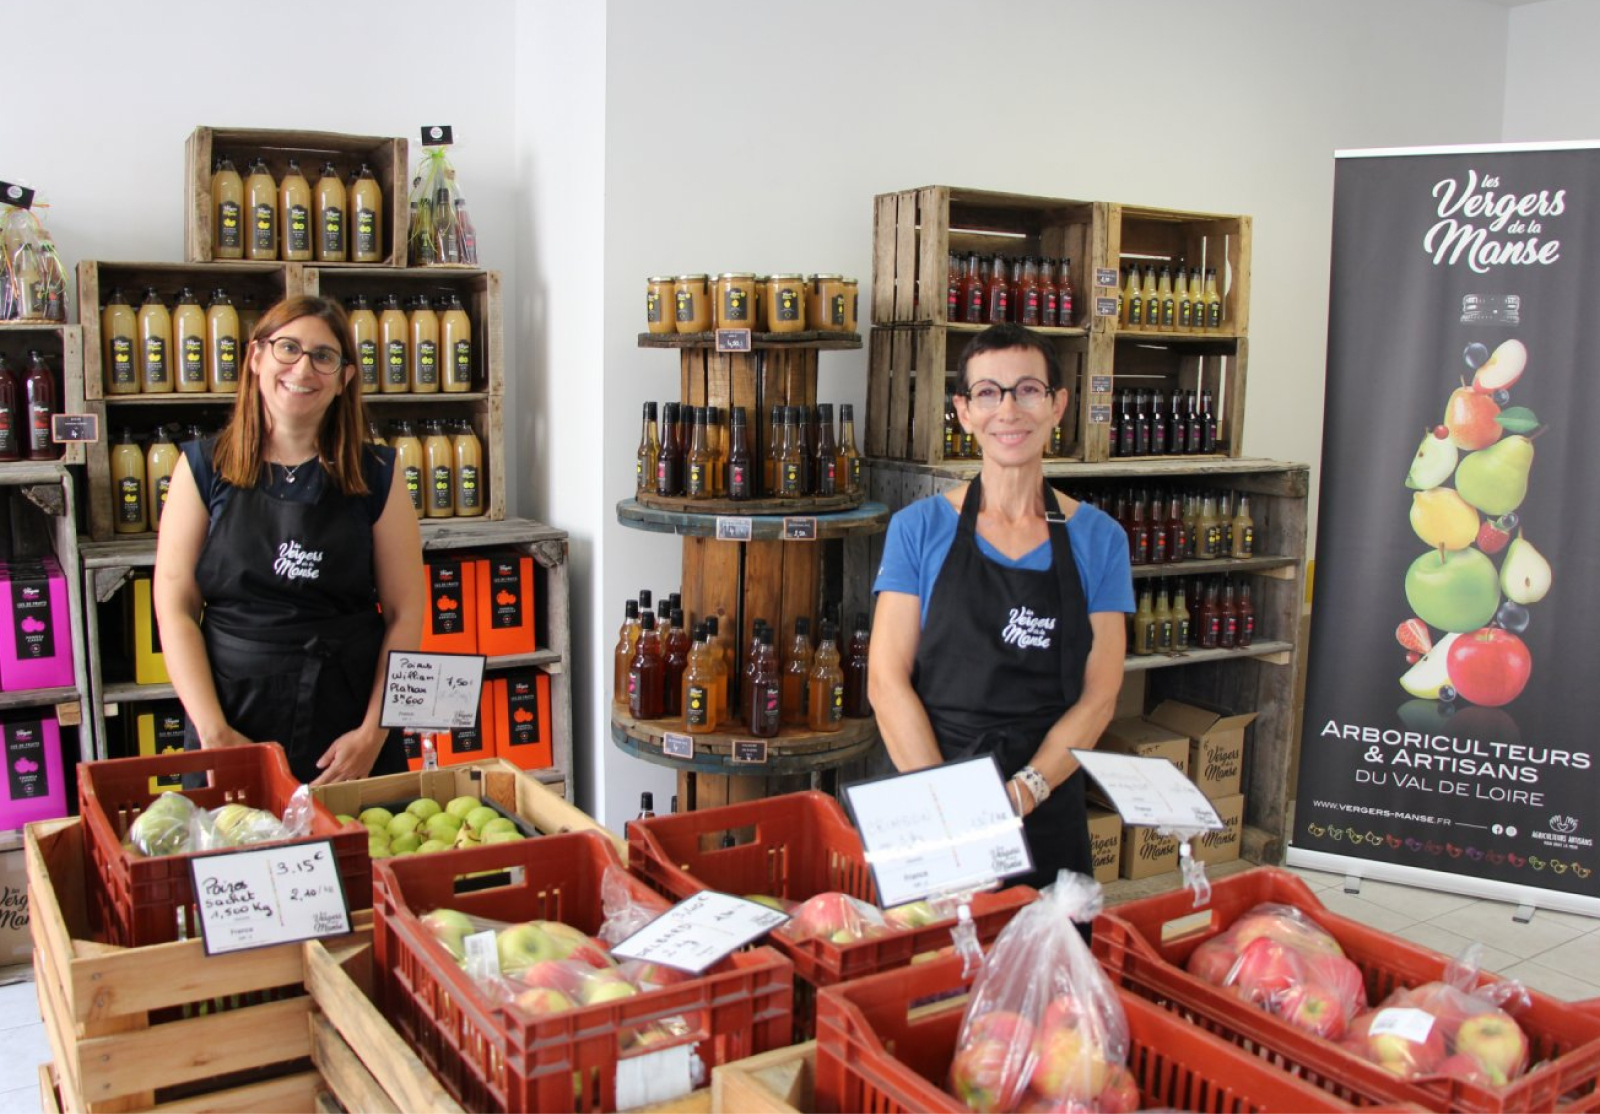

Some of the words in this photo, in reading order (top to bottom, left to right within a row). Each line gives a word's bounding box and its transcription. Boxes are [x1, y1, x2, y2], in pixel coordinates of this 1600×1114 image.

[1432, 169, 1566, 232] Vergers
[1423, 218, 1560, 273] Manse
[1507, 220, 1525, 234] de
[1528, 219, 1542, 234] la
[273, 557, 320, 580] Manse
[1001, 623, 1051, 649] Manse
[1320, 719, 1592, 770] ARBORICULTEURS
[1363, 745, 1384, 763] &
[1391, 748, 1539, 783] ARTISANS
[1355, 769, 1387, 785] DU
[1392, 771, 1434, 792] VAL
[1438, 780, 1470, 797] DE
[1475, 783, 1545, 807] LOIRE
[1312, 800, 1453, 826] WWW.VERGERS-MANSE.FR
